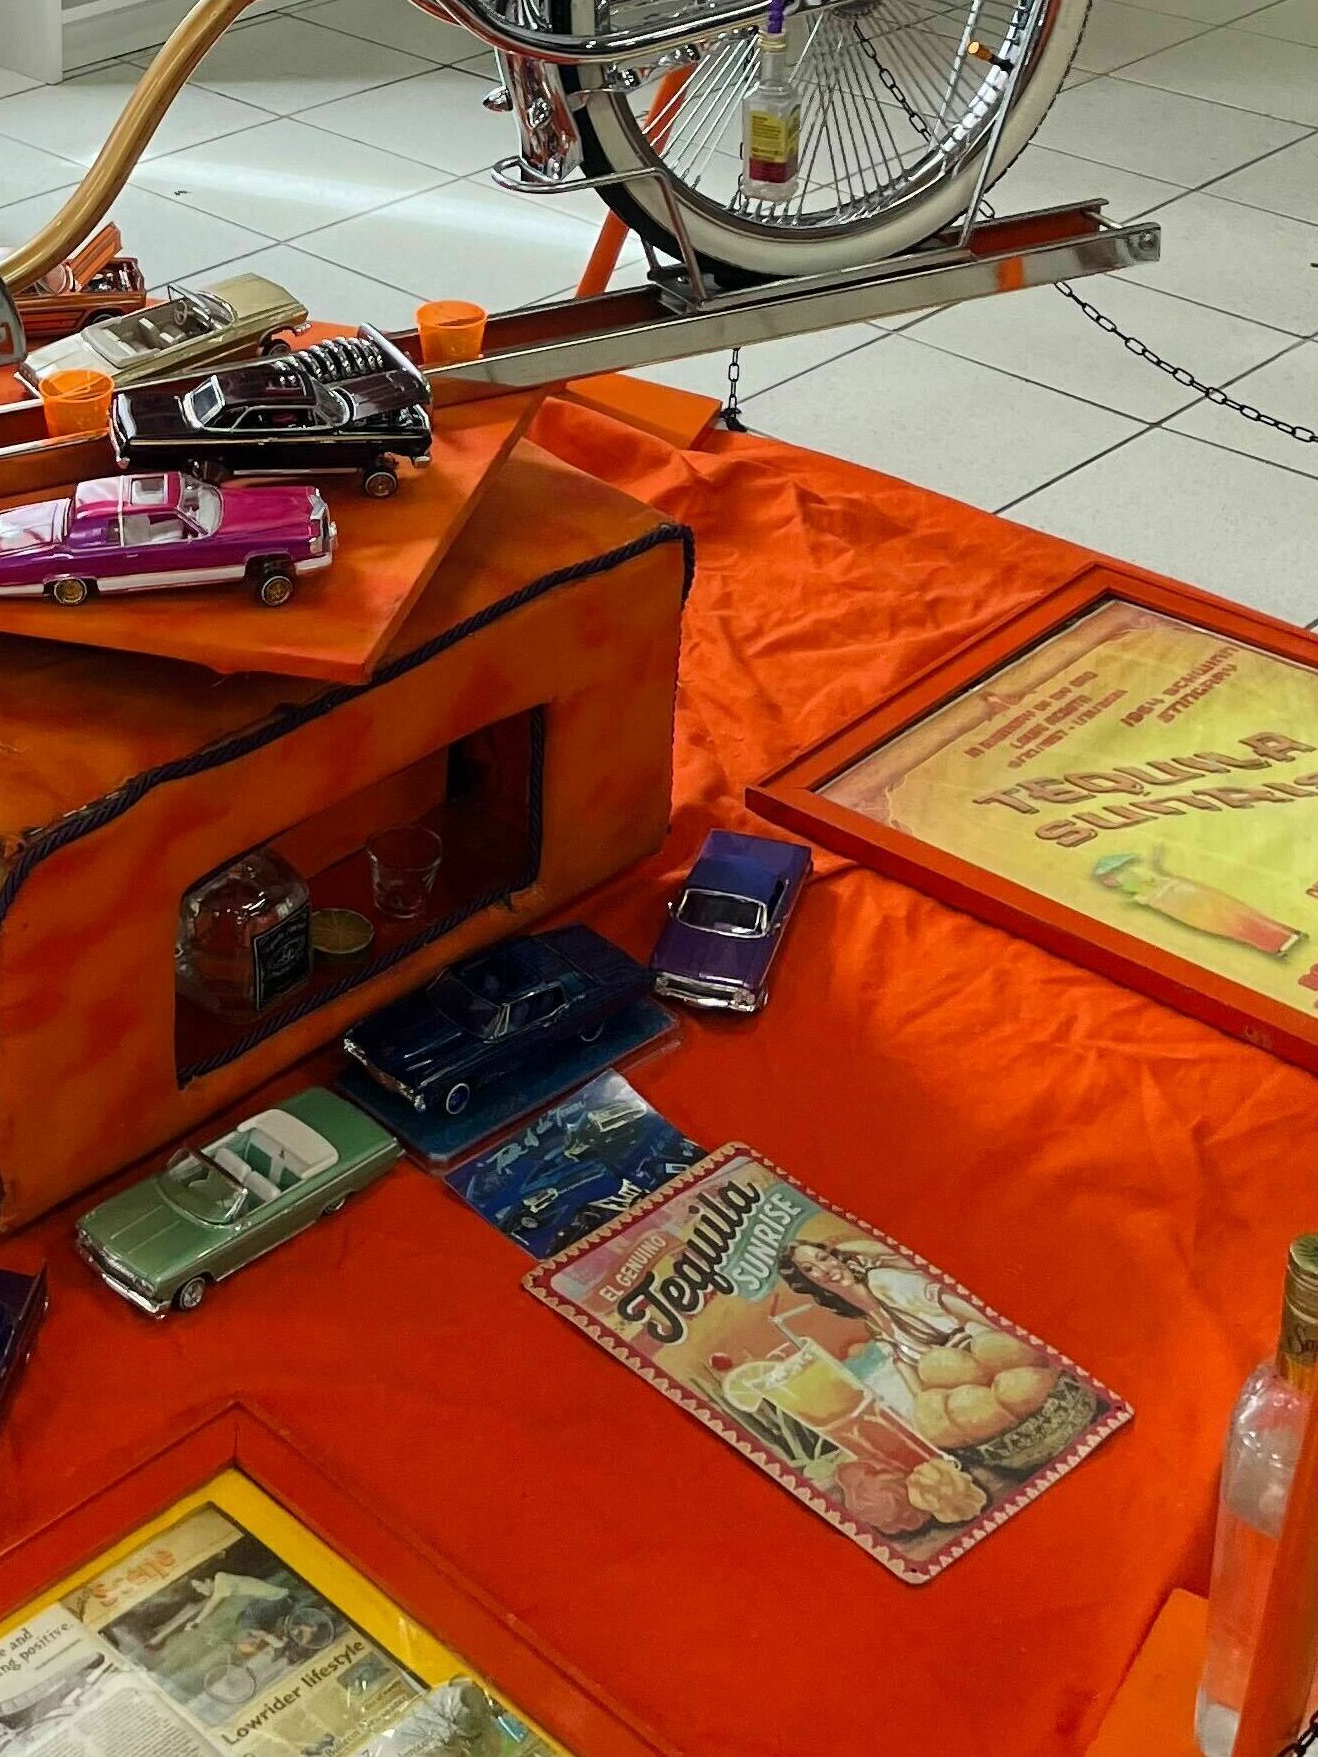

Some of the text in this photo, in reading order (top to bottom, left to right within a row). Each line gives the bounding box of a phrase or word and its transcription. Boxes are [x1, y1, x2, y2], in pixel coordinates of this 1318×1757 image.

[1121, 646, 1241, 727] 1964 SCHWINN
[1157, 665, 1238, 724] STINGRAY
[972, 732, 1317, 814] TEQUILA
[599, 1284, 625, 1303] EL
[615, 1235, 667, 1285] GENUINO
[617, 1180, 761, 1343] Tequila
[733, 1193, 803, 1290] SUNRISE
[9, 1628, 33, 1651] and
[19, 1621, 74, 1664] positive.
[222, 1686, 302, 1745] Lowrider
[301, 1640, 365, 1689] lifestyle
